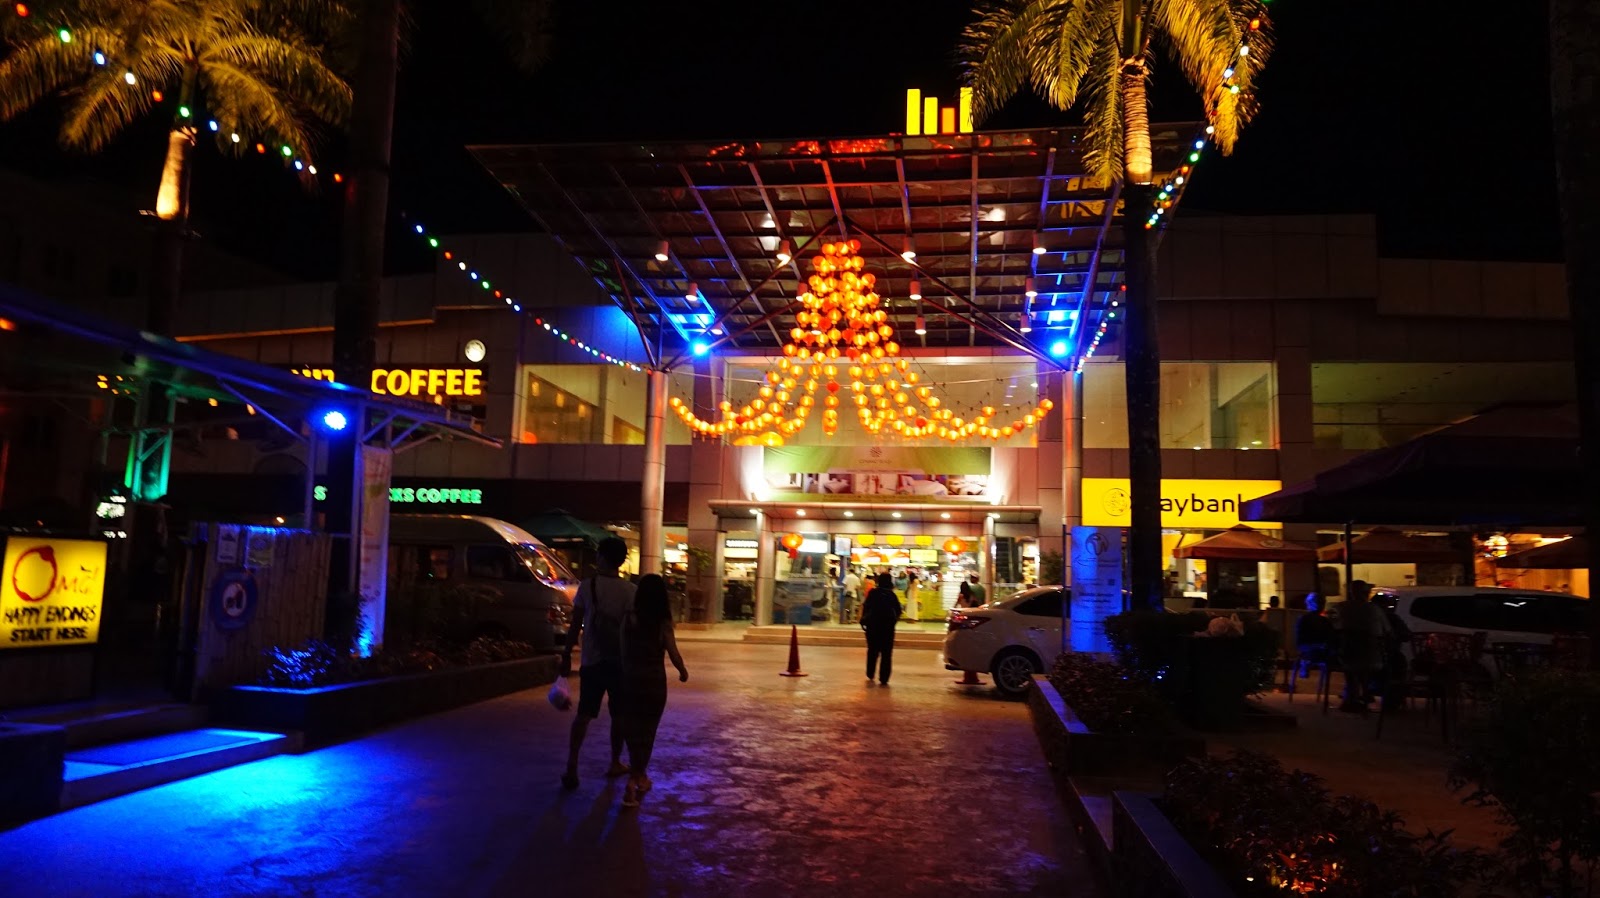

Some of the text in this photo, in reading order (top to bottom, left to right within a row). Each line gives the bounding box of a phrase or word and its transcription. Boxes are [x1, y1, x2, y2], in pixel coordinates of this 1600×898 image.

[371, 368, 482, 396] COFFEE
[416, 487, 482, 504] COFFEE
[1160, 493, 1242, 517] ayban
[4, 604, 97, 625] HAPPY ENDINGS
[10, 626, 88, 642] START HERE
